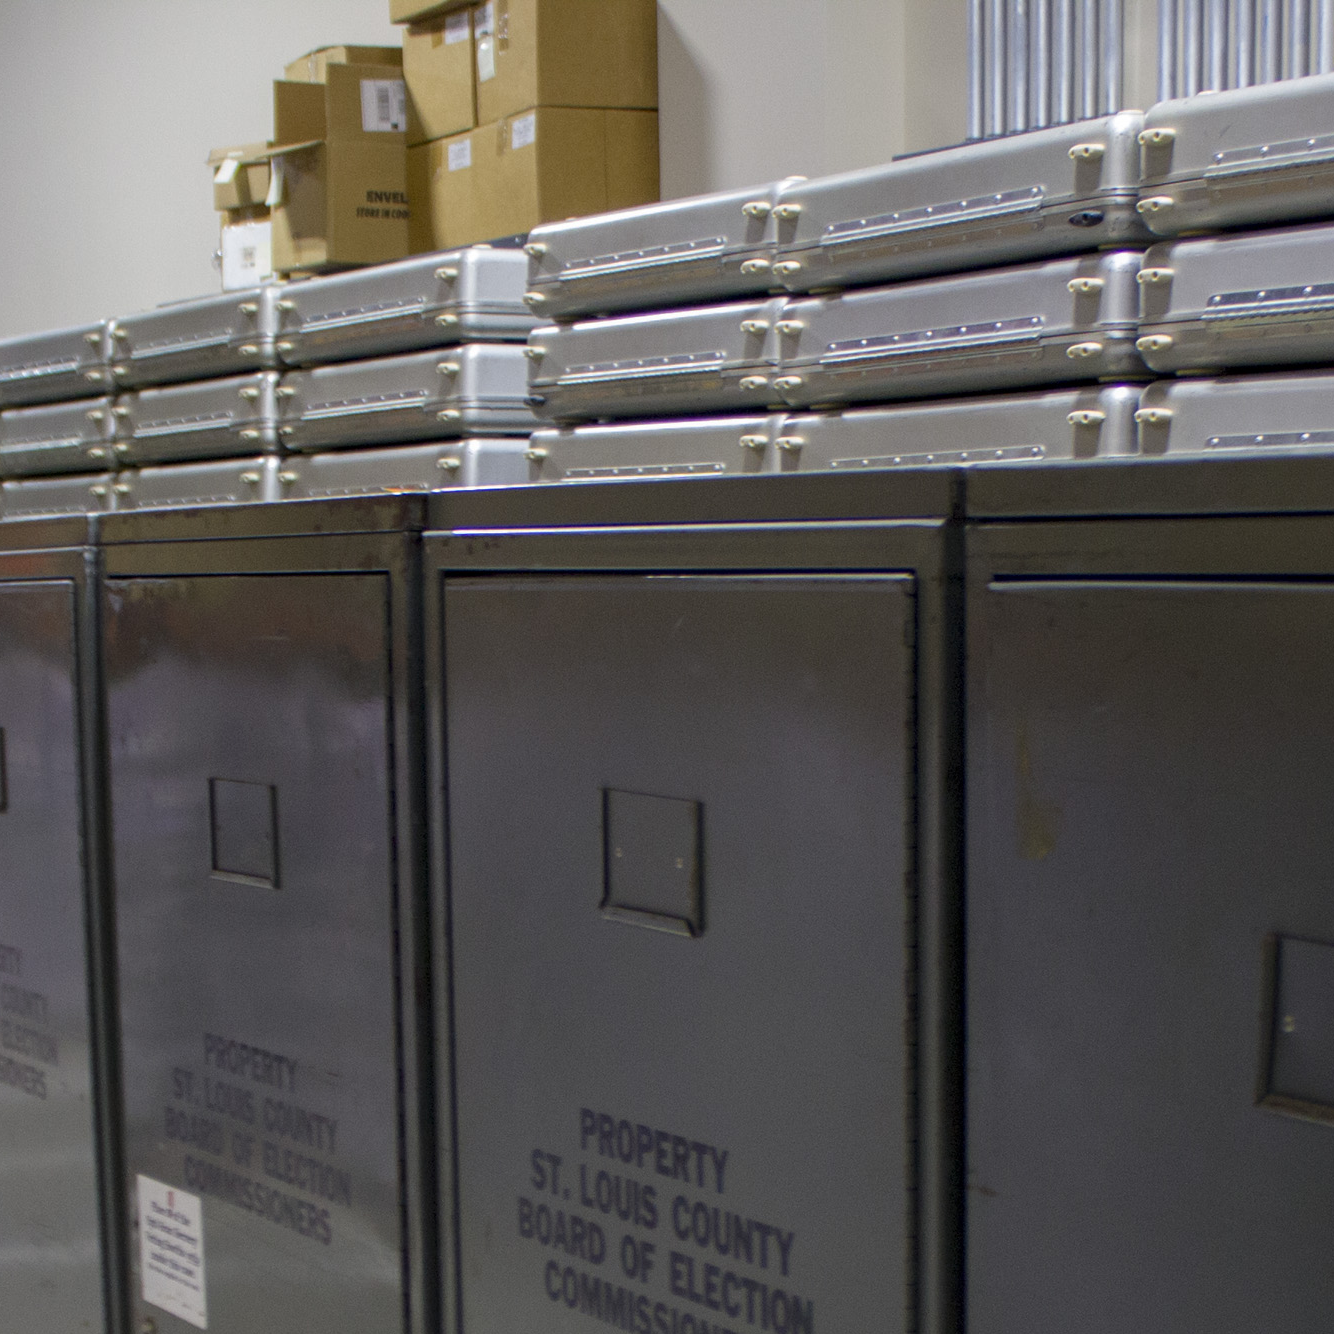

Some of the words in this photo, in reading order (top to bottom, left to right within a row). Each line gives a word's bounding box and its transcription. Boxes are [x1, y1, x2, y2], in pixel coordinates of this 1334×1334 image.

[581, 1107, 728, 1194] PROPERTY
[518, 1197, 606, 1265] BOARD
[621, 1234, 656, 1283] OF
[531, 1149, 570, 1200] ST.
[580, 1163, 658, 1229] LOUIS
[672, 1195, 795, 1277] COUNTY
